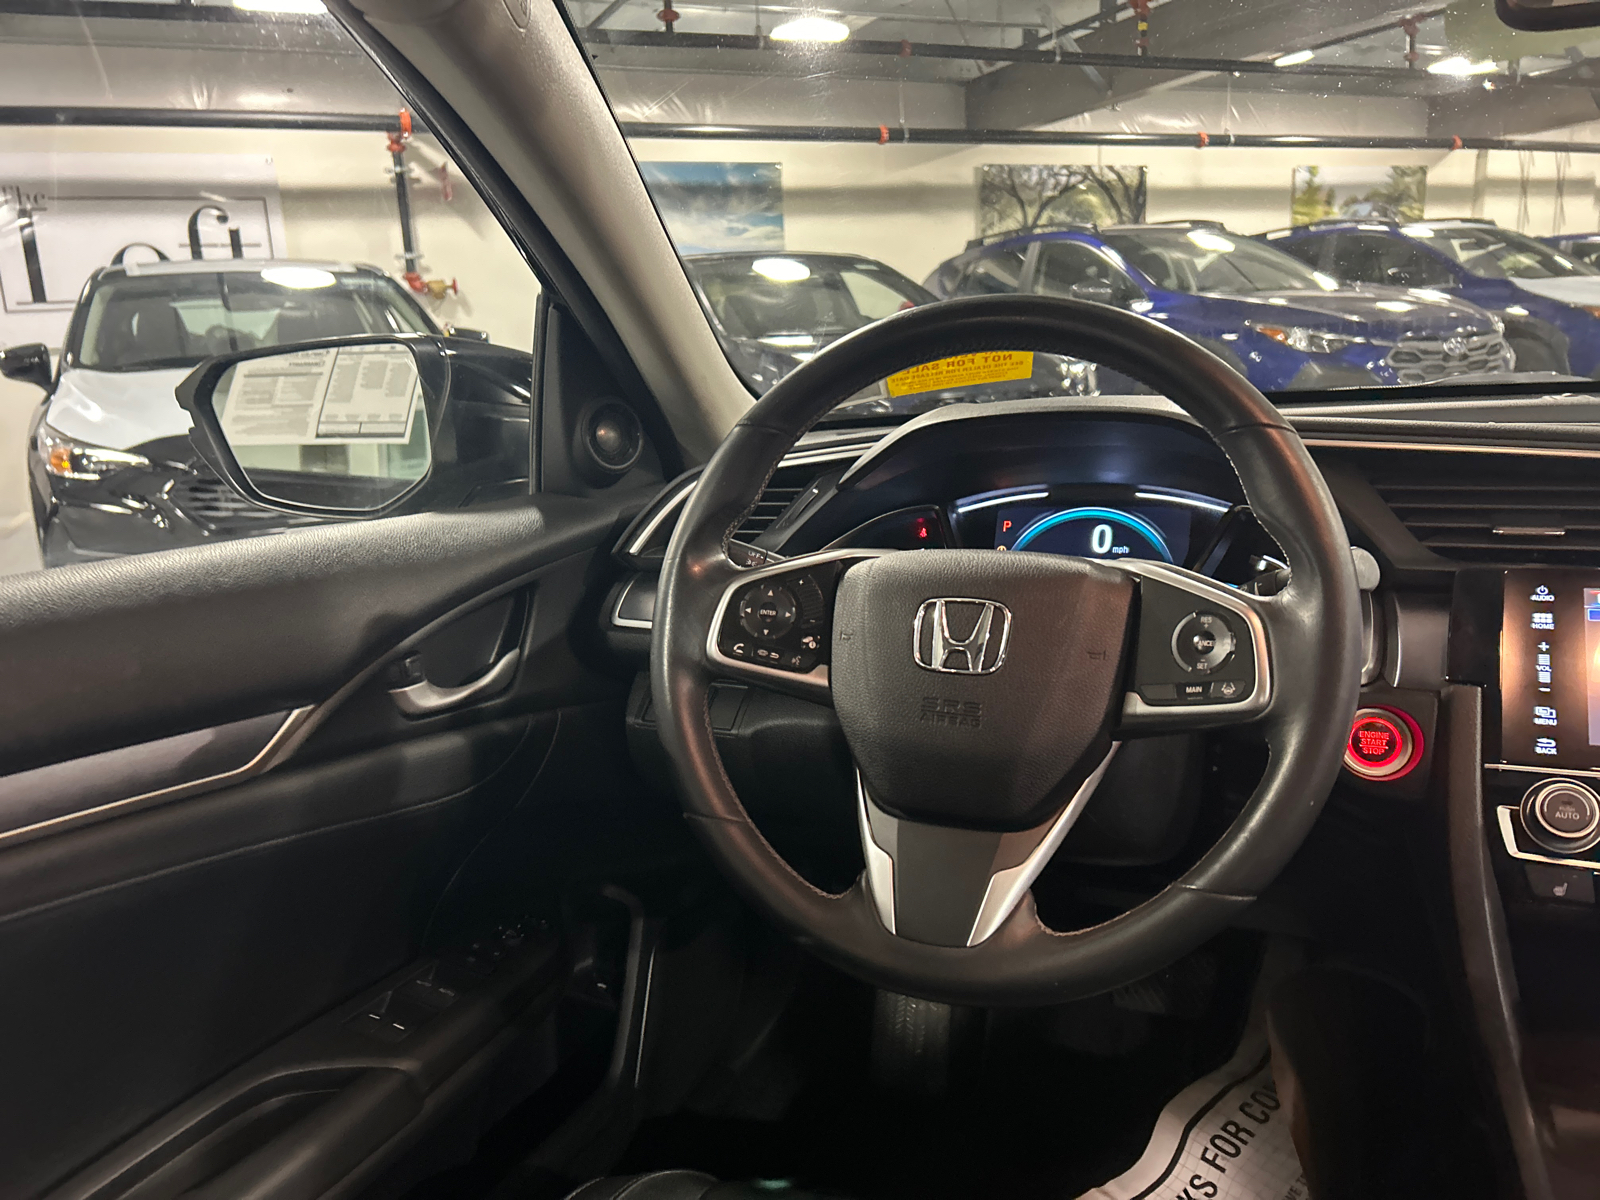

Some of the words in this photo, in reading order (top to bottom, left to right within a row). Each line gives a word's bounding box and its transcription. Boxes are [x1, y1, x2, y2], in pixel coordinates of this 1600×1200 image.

[1003, 520, 1012, 532] P
[1092, 524, 1113, 554] 0
[1112, 546, 1129, 554] mph
[1530, 594, 1555, 602] AUDIO
[1196, 662, 1208, 670] SET
[1533, 718, 1557, 726] MENU
[1359, 730, 1390, 740] ENGINE
[1361, 738, 1388, 746] START
[1362, 747, 1386, 755] STOP
[1554, 811, 1580, 820] AUTO
[1200, 1119, 1256, 1174] FOR
